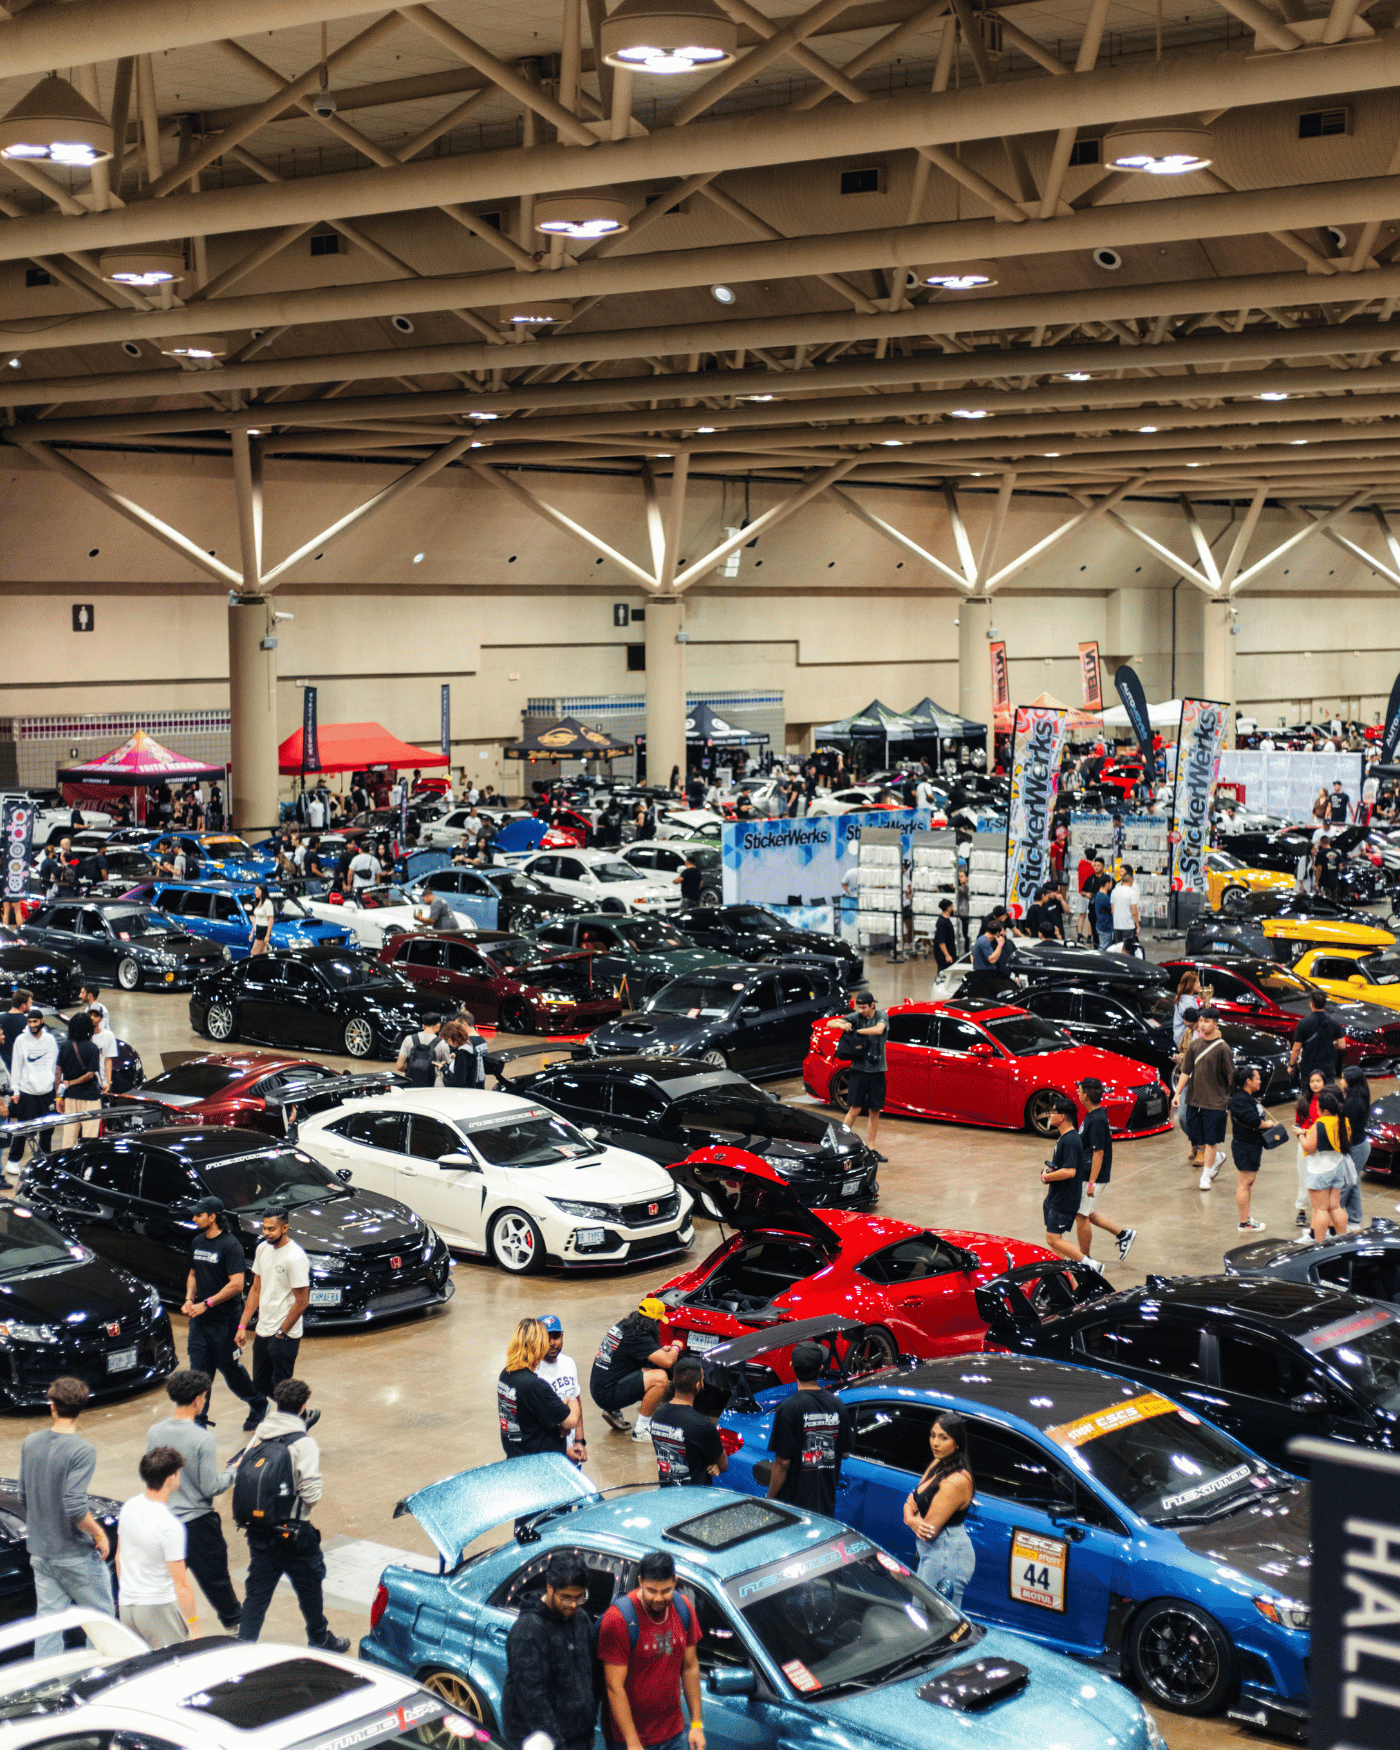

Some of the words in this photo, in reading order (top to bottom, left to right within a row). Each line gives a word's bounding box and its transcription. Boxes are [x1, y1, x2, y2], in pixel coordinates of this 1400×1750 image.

[1180, 710, 1217, 875] StickerWerks
[1018, 719, 1055, 899] StickerWerks
[744, 829, 828, 850] StickerWerks
[1095, 1407, 1138, 1428] CSCS
[1017, 1533, 1064, 1553] CSCS
[1023, 1563, 1050, 1591] 44
[1022, 1590, 1052, 1604] MOTUL
[1343, 1517, 1400, 1718] HALL
